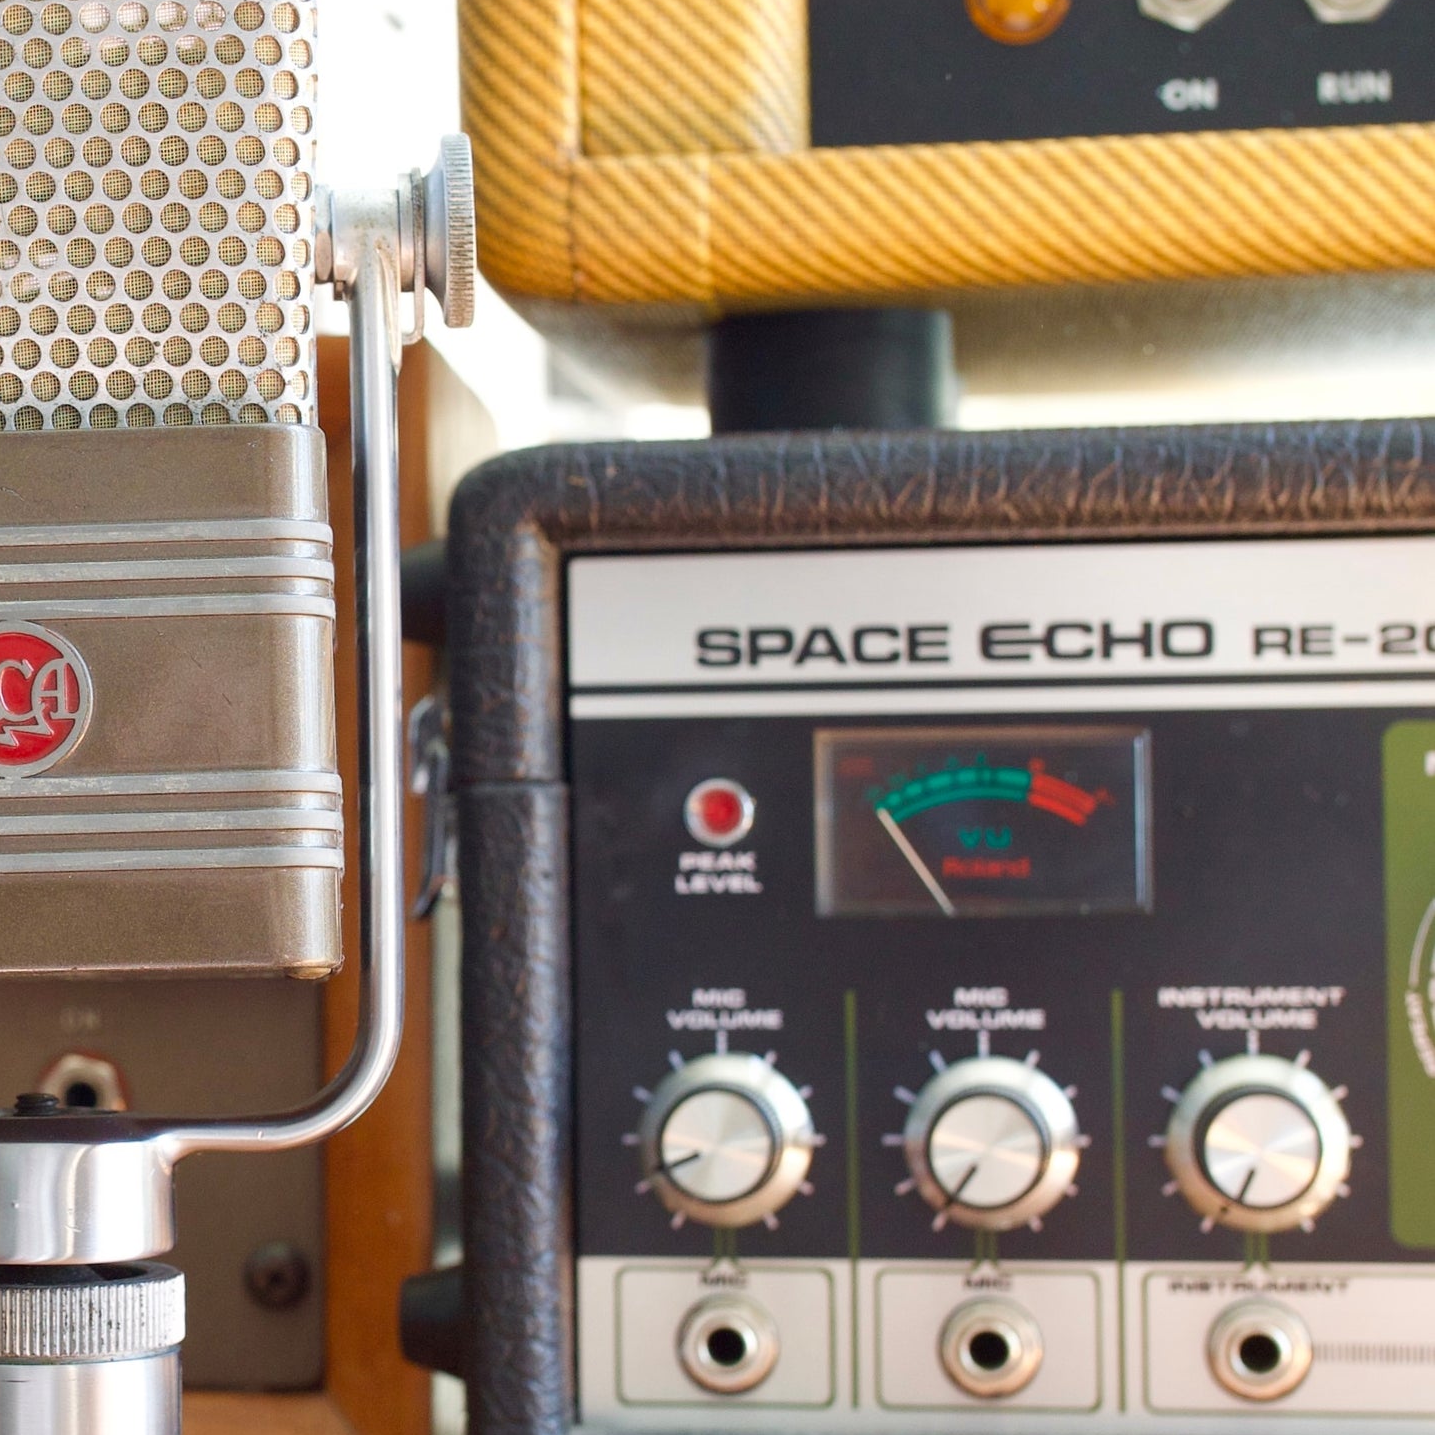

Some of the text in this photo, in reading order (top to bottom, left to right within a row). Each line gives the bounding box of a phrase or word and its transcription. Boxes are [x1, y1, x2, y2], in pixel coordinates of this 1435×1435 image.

[1159, 77, 1218, 111] ON
[1317, 70, 1393, 105] RUN
[696, 623, 950, 668] SPACE
[980, 619, 1215, 661] ECHO
[958, 826, 1013, 850] VU
[679, 851, 757, 872] PEAK
[675, 873, 762, 896] LEVEL
[691, 987, 746, 1008] MIC
[953, 987, 1009, 1007] MIC
[1156, 986, 1344, 1008] INSTRUMENT
[666, 1009, 784, 1030] VOLUME
[926, 1009, 1045, 1030] VOLUME
[1195, 1009, 1317, 1030] VOLUME
